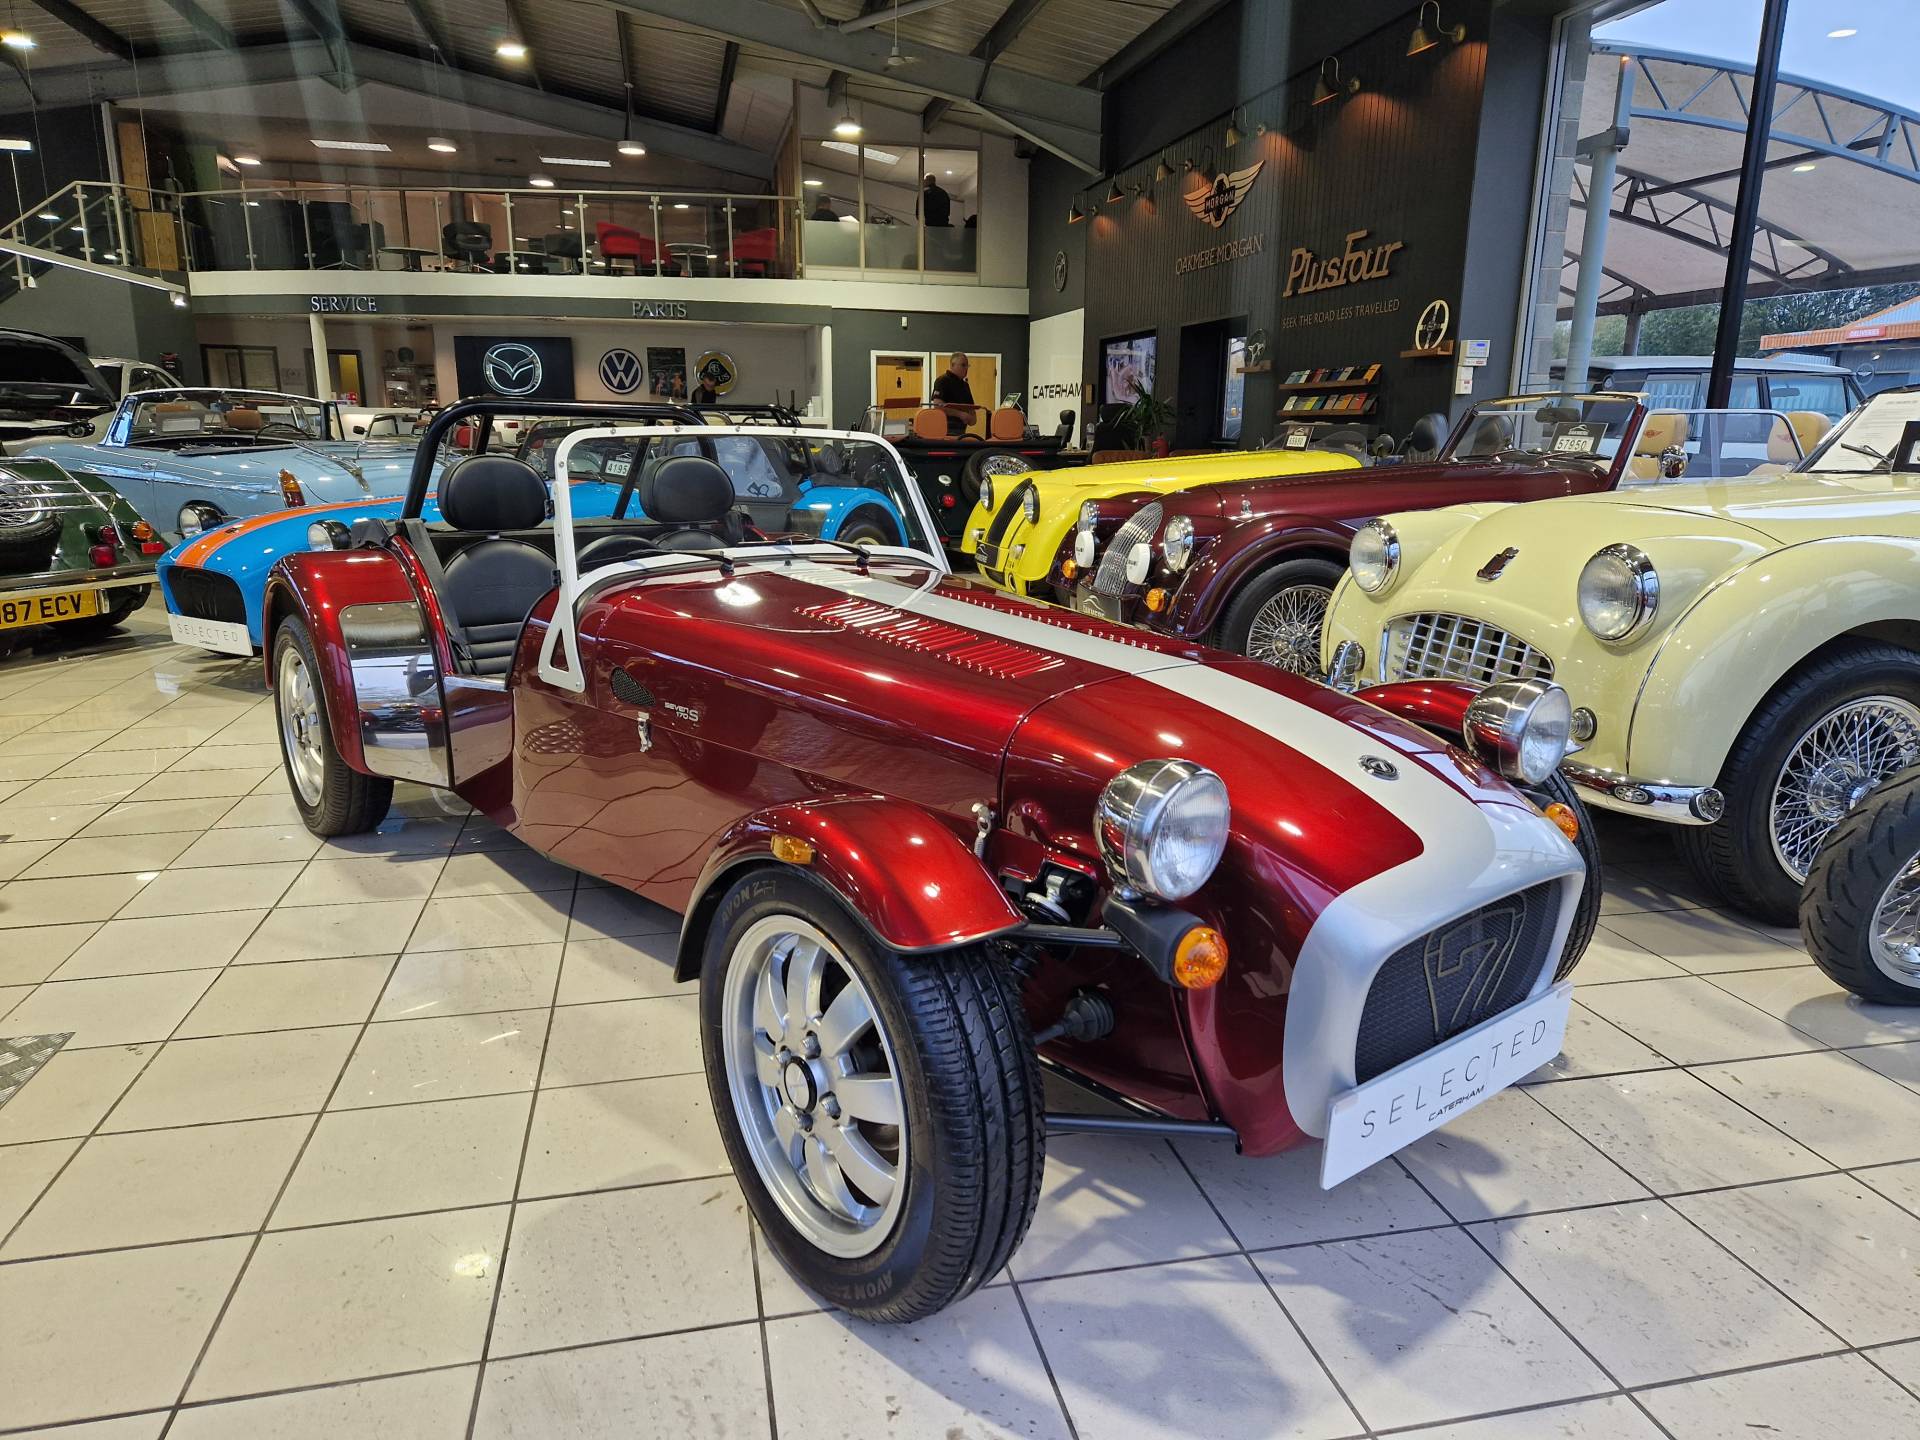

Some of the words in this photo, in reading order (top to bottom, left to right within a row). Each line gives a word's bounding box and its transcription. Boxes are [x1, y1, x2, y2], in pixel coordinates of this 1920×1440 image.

[1205, 188, 1235, 211] MORGAN
[1175, 247, 1217, 275] OAKMERE
[1216, 233, 1265, 263] MORGAN
[310, 295, 377, 313] SERVICE
[632, 301, 688, 318] PARTS
[1282, 317, 1298, 329] SEEK
[1300, 313, 1313, 326] THE
[1314, 310, 1336, 323] ROAD
[1336, 305, 1354, 320] LESS
[1355, 298, 1401, 317] TRAVELLED
[1032, 382, 1082, 399] CATERHAM
[1558, 439, 1588, 450] 57950
[0, 603, 31, 625] 87
[40, 593, 82, 619] ECV
[177, 623, 239, 642] SELECTED
[721, 885, 751, 929] AVON
[1360, 1018, 1548, 1139] SELECTED
[1428, 1084, 1486, 1122] CATERHAM
